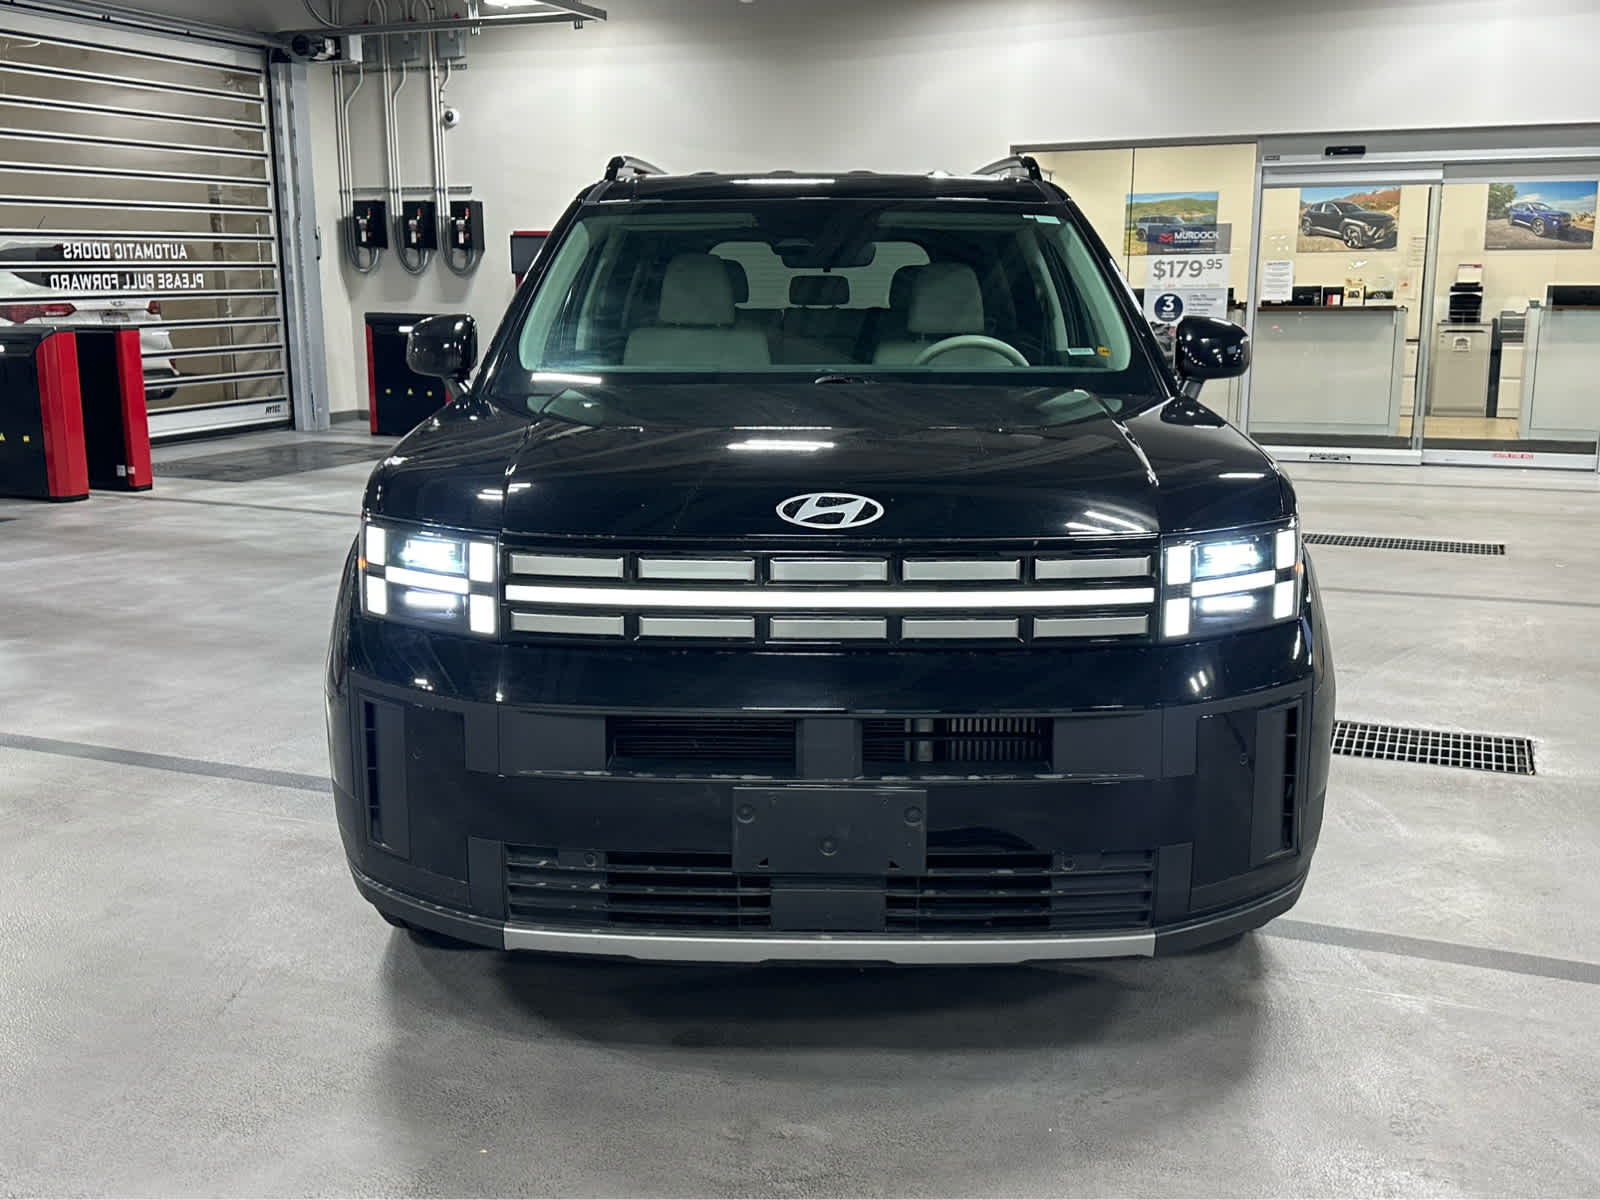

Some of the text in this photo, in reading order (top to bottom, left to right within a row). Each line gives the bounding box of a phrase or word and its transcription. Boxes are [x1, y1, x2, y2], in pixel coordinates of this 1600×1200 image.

[1174, 231, 1221, 240] MURDOCK
[1153, 258, 1223, 280] $179.95
[1162, 296, 1175, 311] 3
